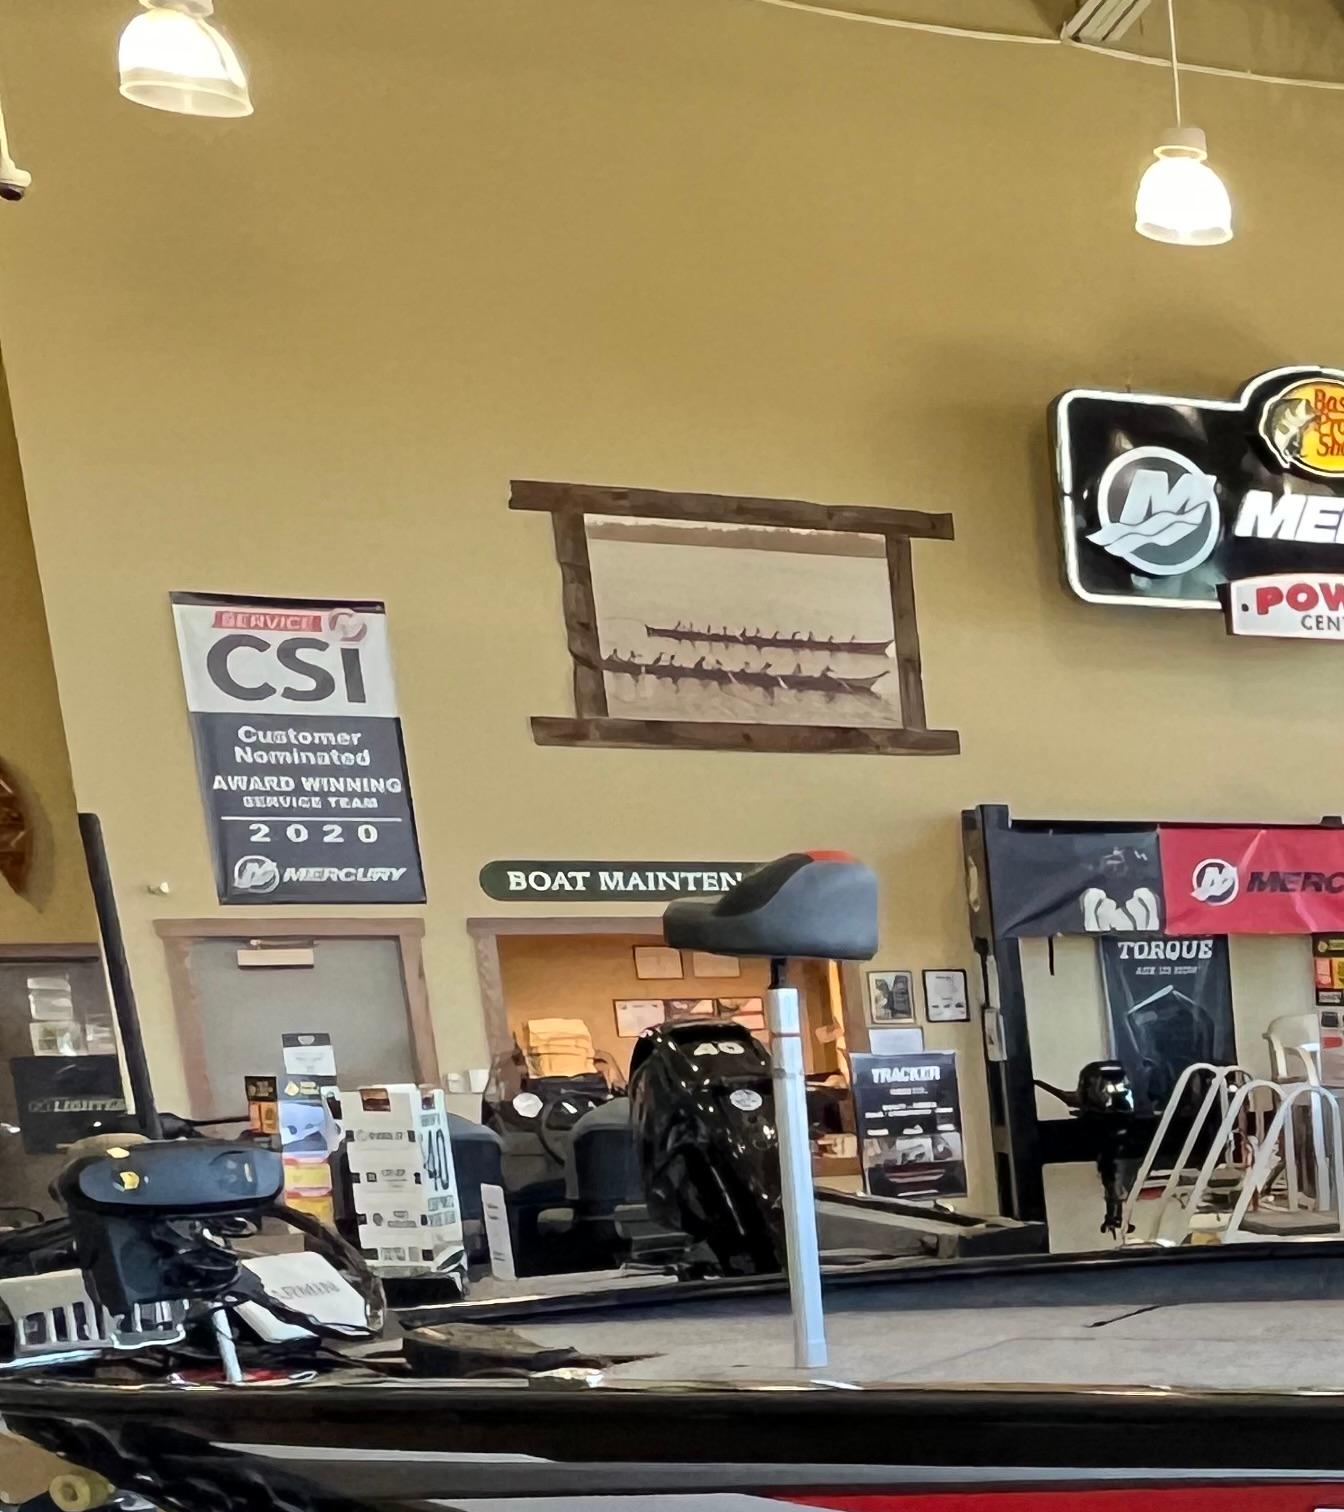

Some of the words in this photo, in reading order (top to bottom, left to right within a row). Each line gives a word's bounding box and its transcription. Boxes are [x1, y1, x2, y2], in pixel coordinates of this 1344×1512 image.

[220, 612, 317, 632] SERVICE
[237, 725, 362, 746] Customer
[233, 746, 371, 767] Nominated
[212, 775, 296, 792] AWARD
[301, 776, 403, 794] WINNING
[242, 795, 322, 809] SERVICE
[327, 796, 379, 809] TEAM
[282, 866, 408, 882] MERCURY
[506, 871, 591, 892] BOAT
[1117, 940, 1214, 960] TORQUE
[870, 1065, 942, 1084] TRACKER
